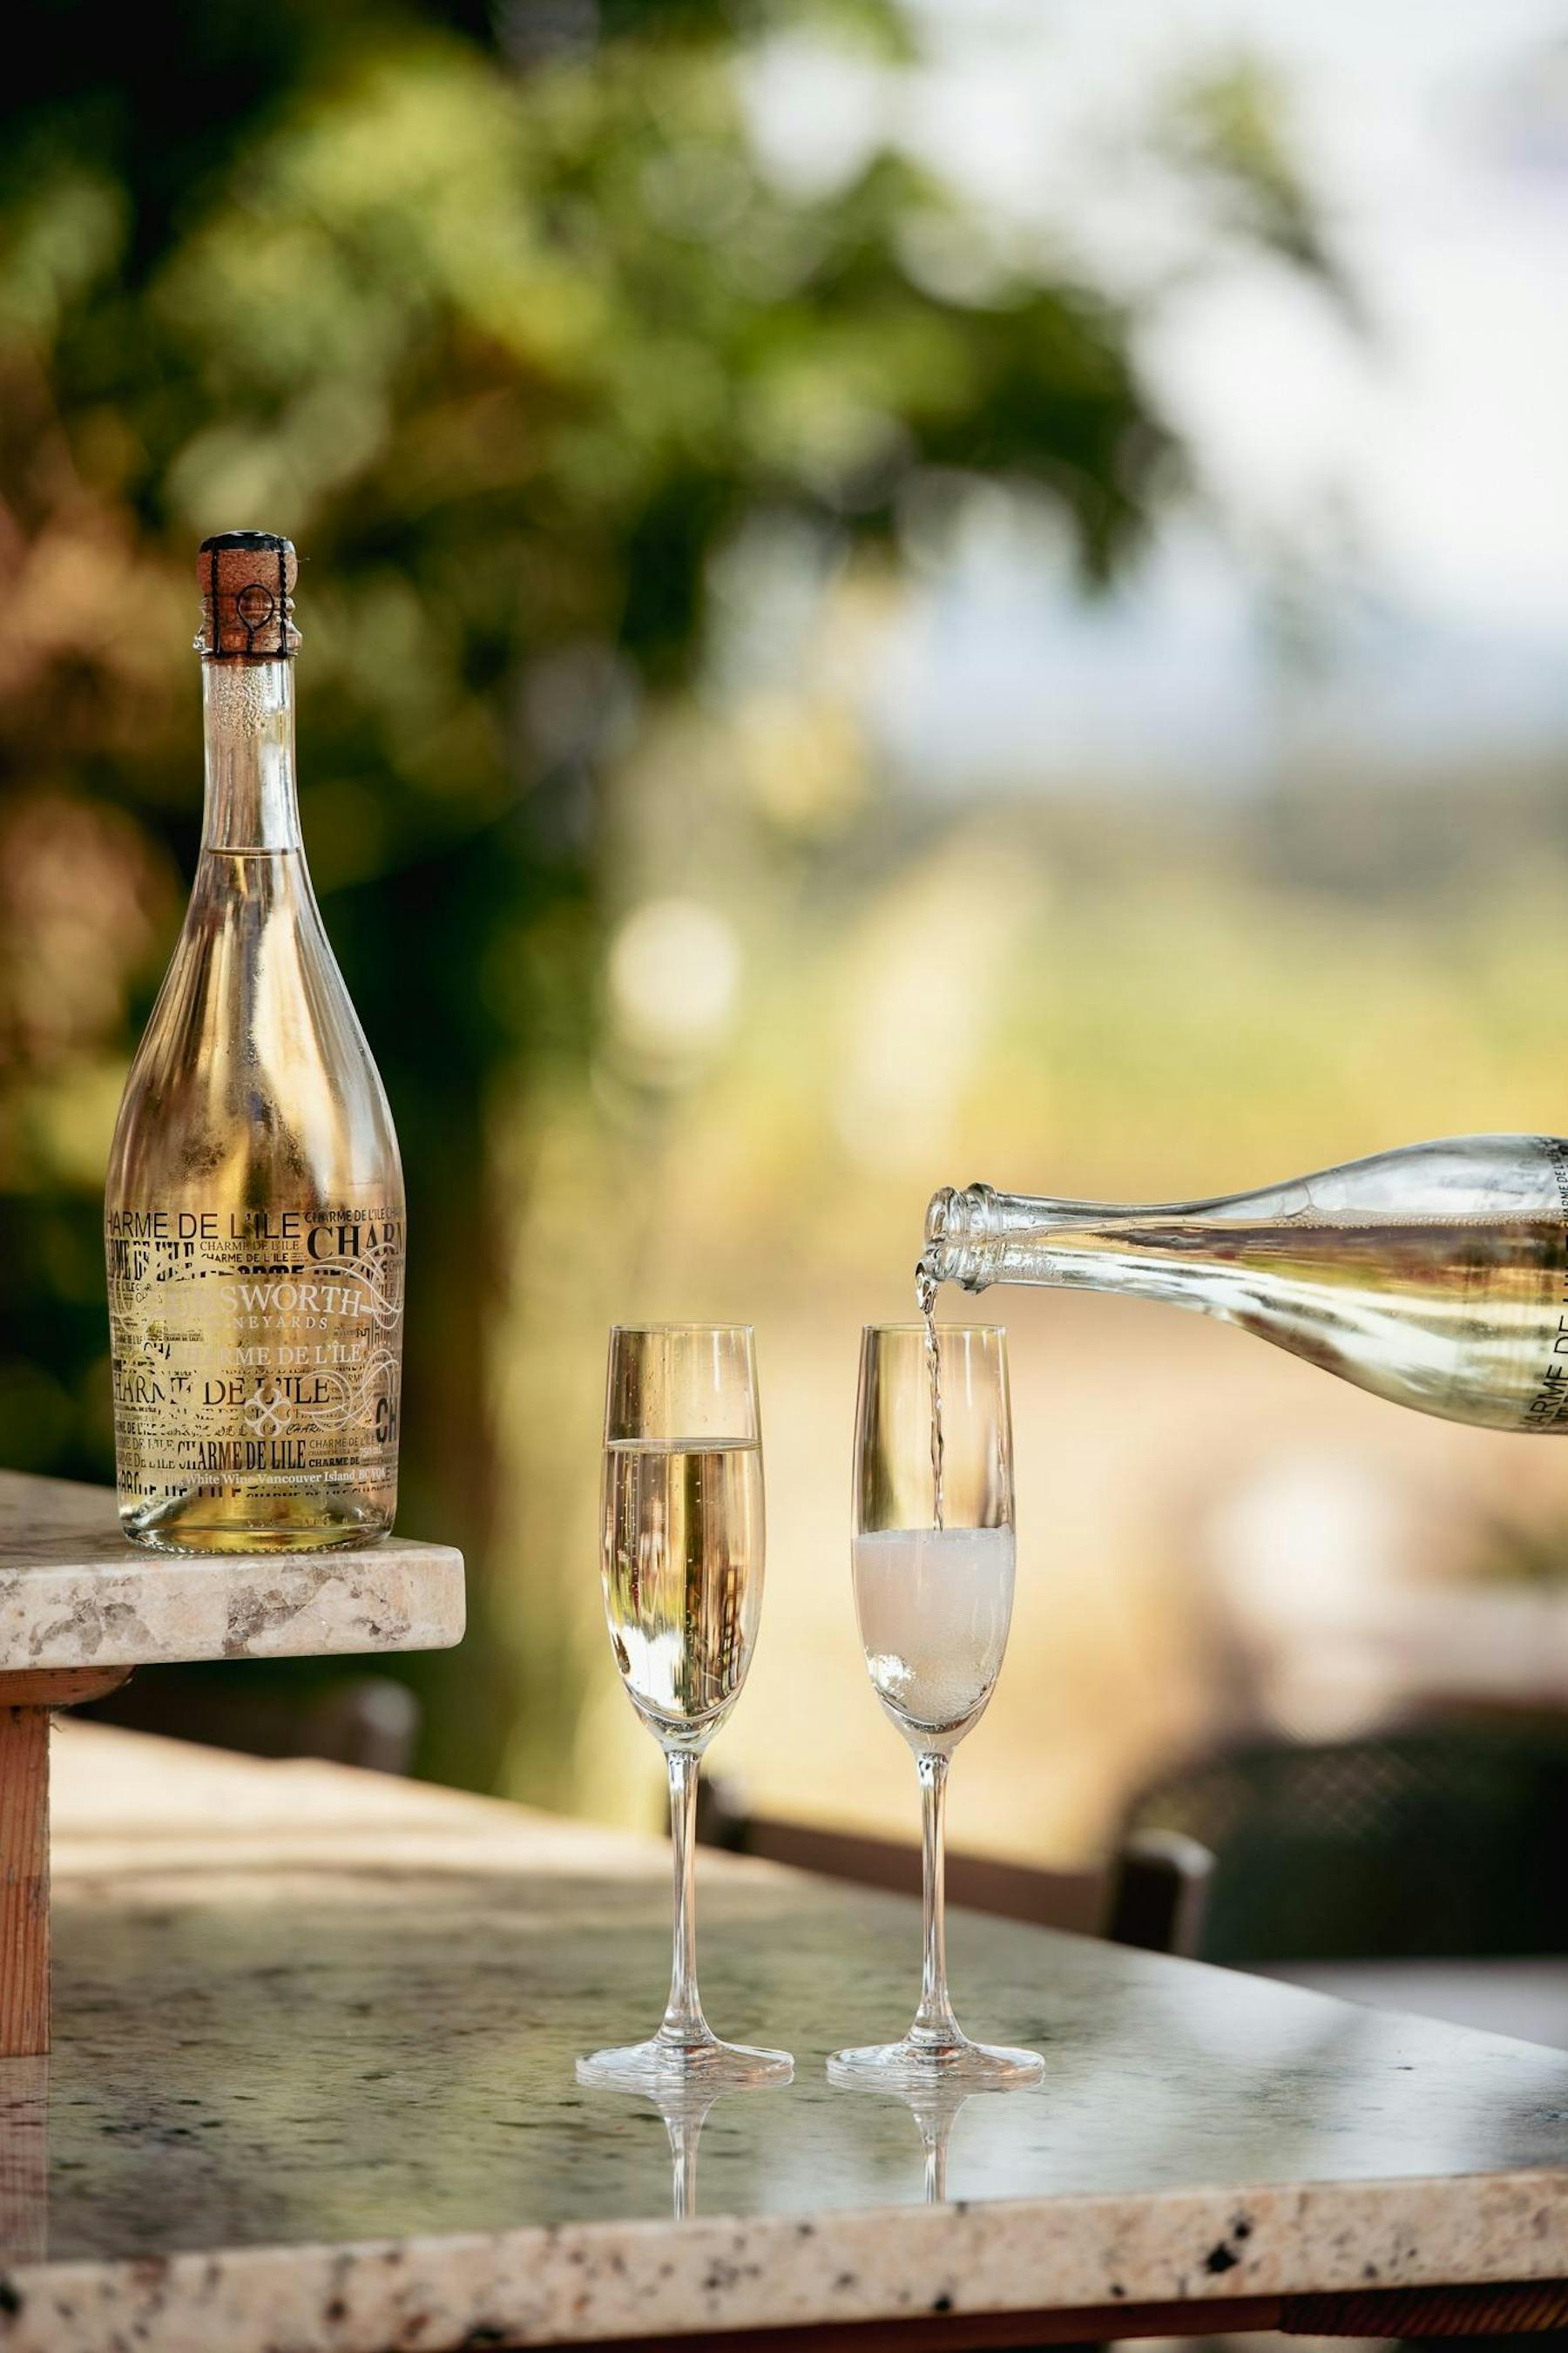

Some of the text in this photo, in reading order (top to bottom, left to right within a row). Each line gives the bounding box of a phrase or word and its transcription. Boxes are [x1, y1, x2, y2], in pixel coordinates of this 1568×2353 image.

[179, 1213, 219, 1239] DE
[230, 1212, 301, 1240] L'ILE
[199, 1241, 251, 1252] CHARME
[253, 1241, 268, 1251] DE
[247, 1253, 260, 1262] DE
[277, 1346, 309, 1366] DE
[202, 1377, 247, 1405] DE
[309, 1437, 347, 1449] CHARME
[348, 1437, 359, 1446] DE
[246, 1440, 267, 1471] DE
[308, 1457, 348, 1468] CHARME
[349, 1456, 360, 1465] DE
[257, 1471, 322, 1485] Vancouver
[323, 1469, 355, 1483] Island
